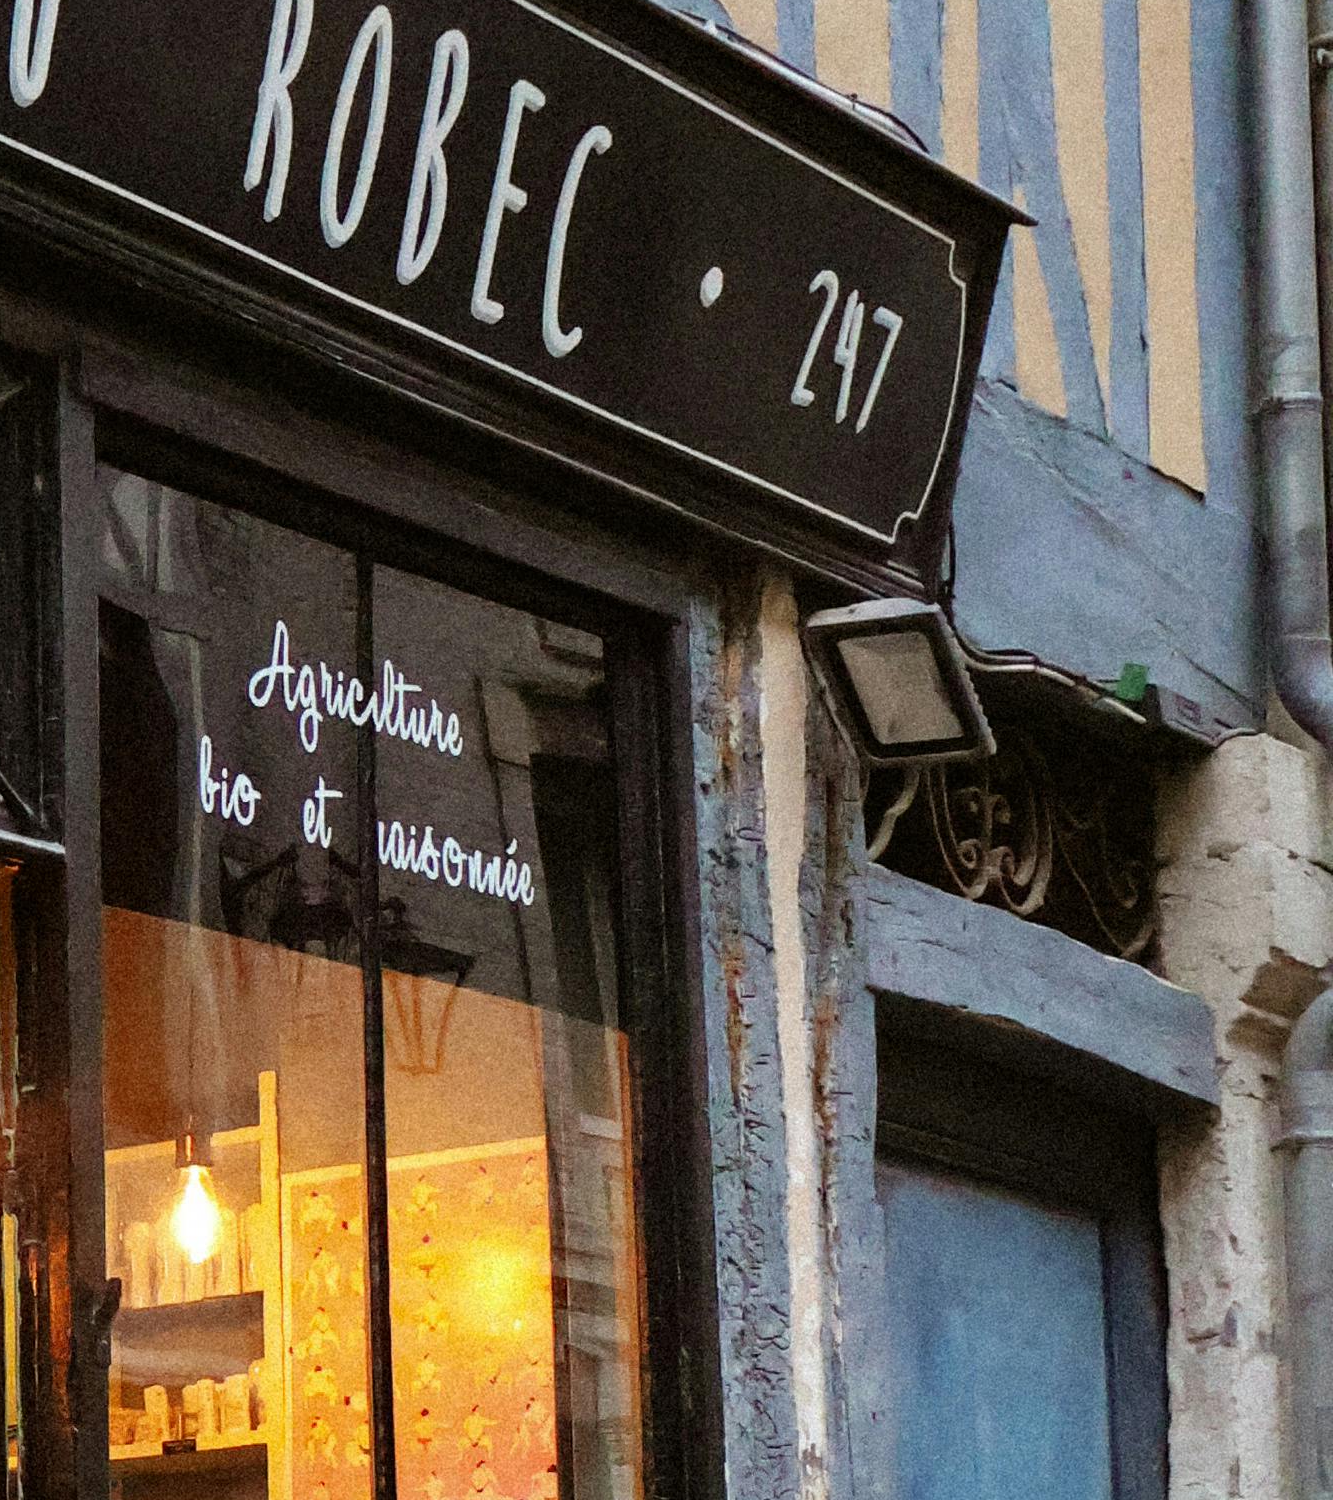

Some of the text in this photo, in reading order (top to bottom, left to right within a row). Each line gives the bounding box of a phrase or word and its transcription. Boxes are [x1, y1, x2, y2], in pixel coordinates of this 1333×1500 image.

[790, 269, 904, 432] 247
[199, 735, 262, 826] bio
[303, 777, 343, 849] et
